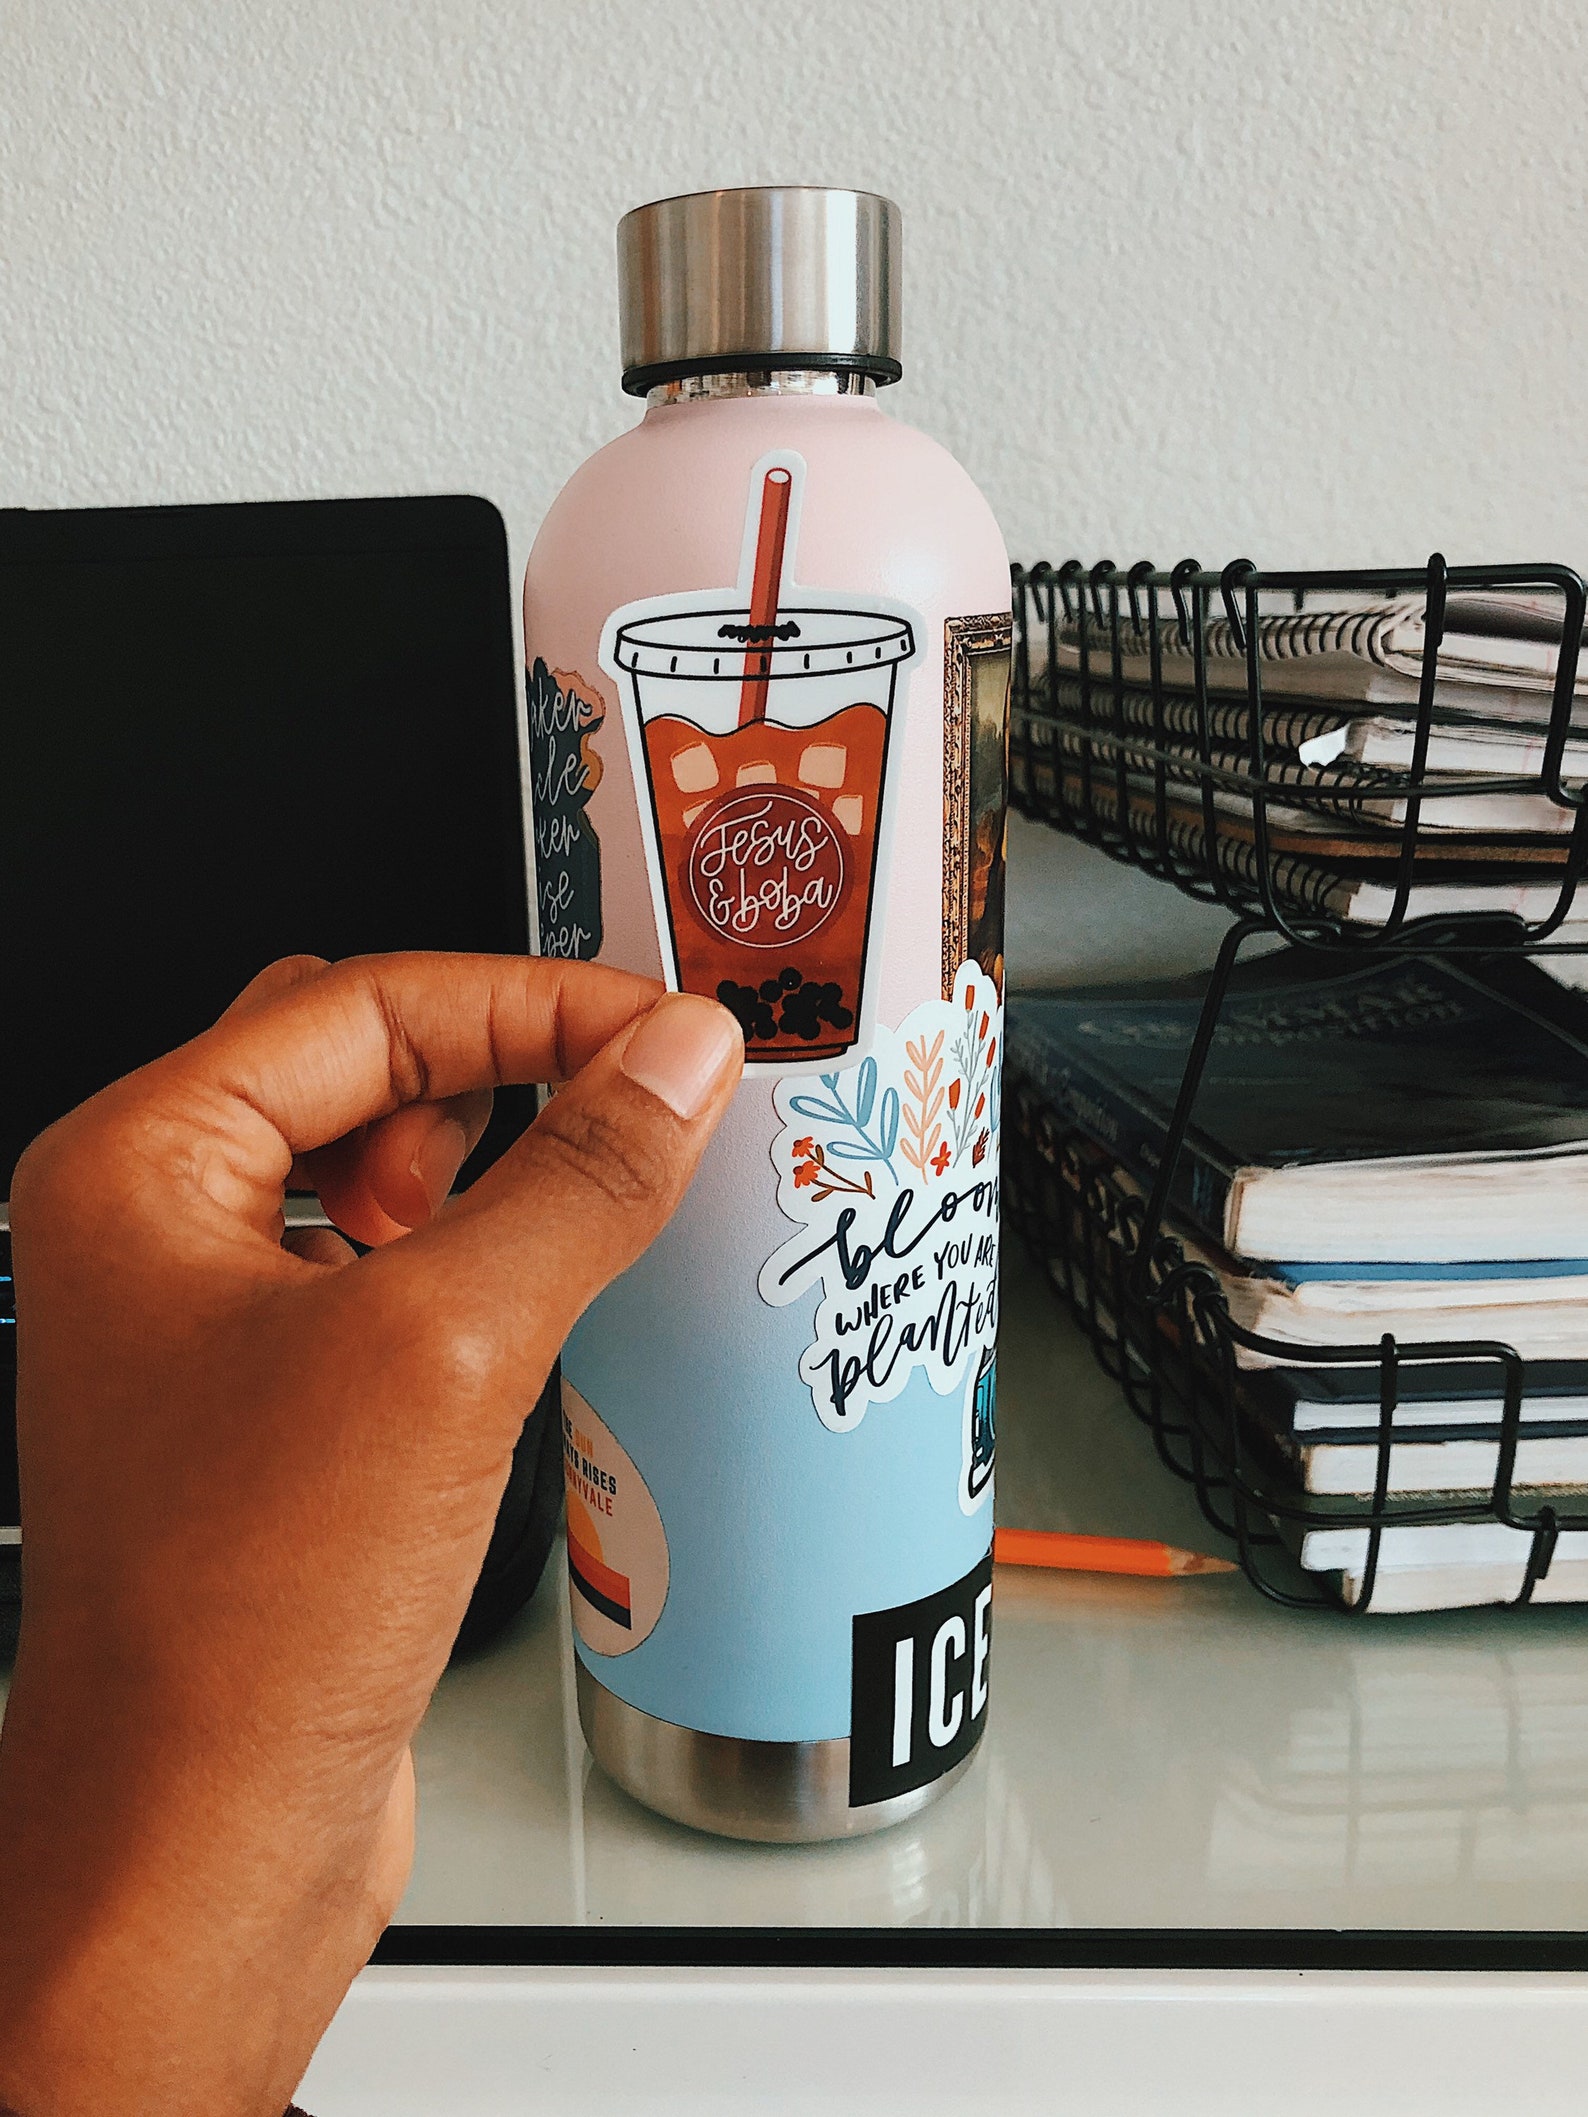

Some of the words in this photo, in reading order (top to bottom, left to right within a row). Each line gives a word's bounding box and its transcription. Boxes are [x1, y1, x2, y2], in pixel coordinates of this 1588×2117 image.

[700, 800, 829, 877] Jesus
[835, 1264, 926, 1336] WHERE
[934, 1233, 973, 1280] YOU
[974, 1233, 997, 1269] ARE
[809, 1262, 997, 1416] planted
[582, 1456, 617, 1496] RISES
[892, 1583, 993, 1768] ICE
